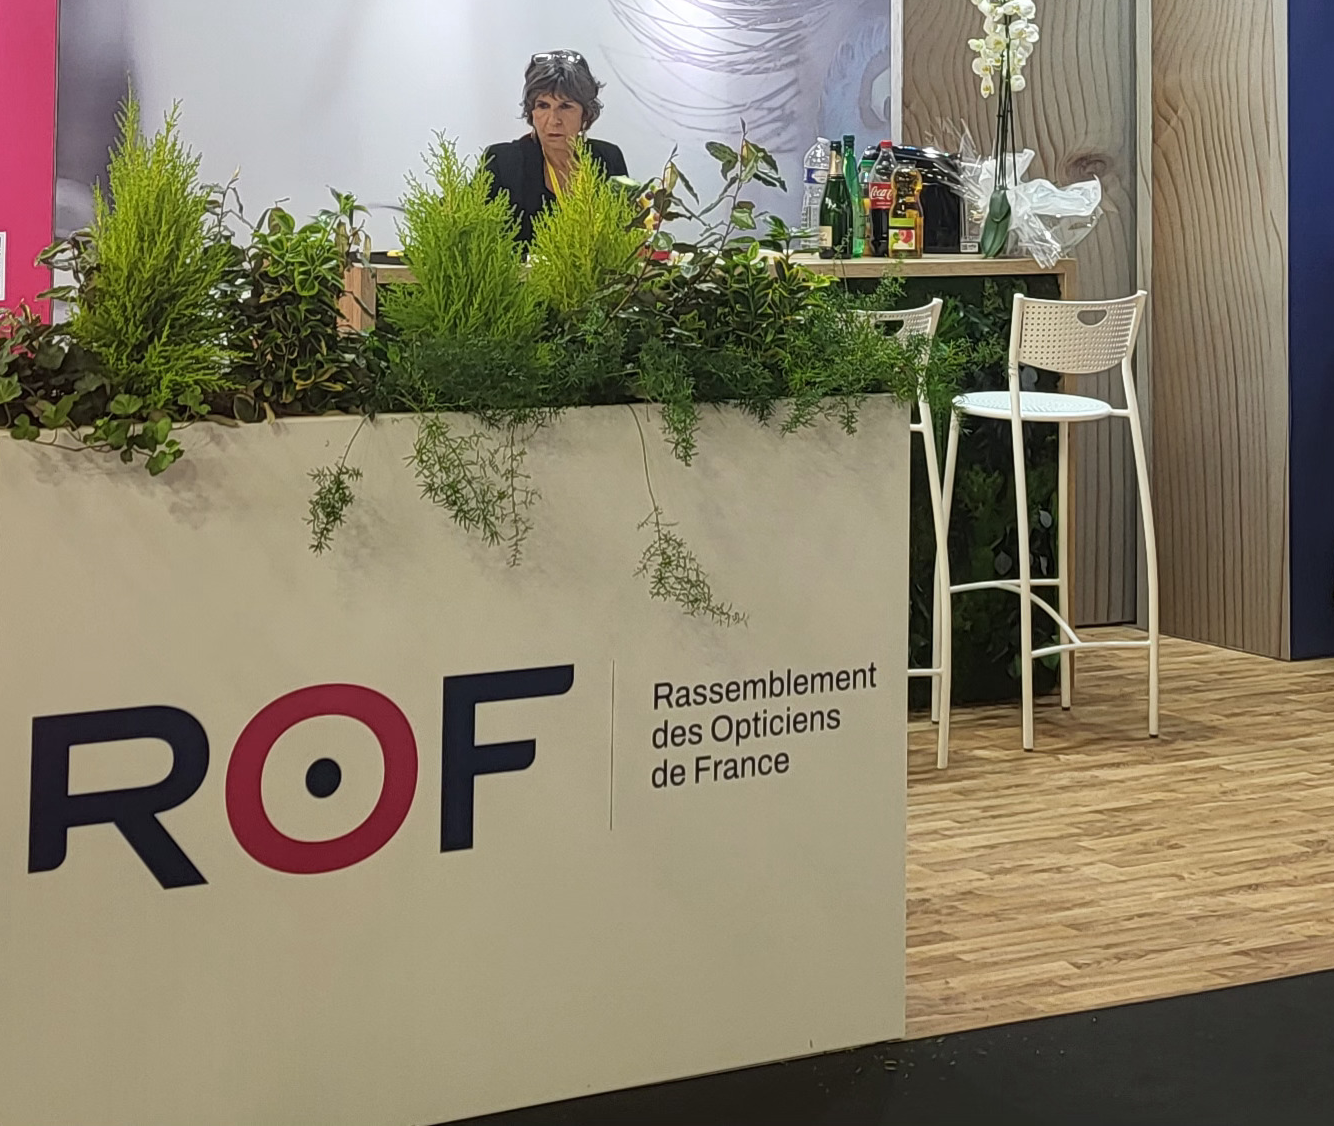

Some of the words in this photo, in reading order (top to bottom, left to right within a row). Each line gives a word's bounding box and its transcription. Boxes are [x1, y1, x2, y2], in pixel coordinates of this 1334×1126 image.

[652, 661, 878, 711] Rassemblement
[650, 718, 705, 750] des
[711, 704, 842, 742] Opticiens
[28, 664, 574, 890] ROF
[650, 758, 688, 790] de
[694, 750, 791, 783] France
